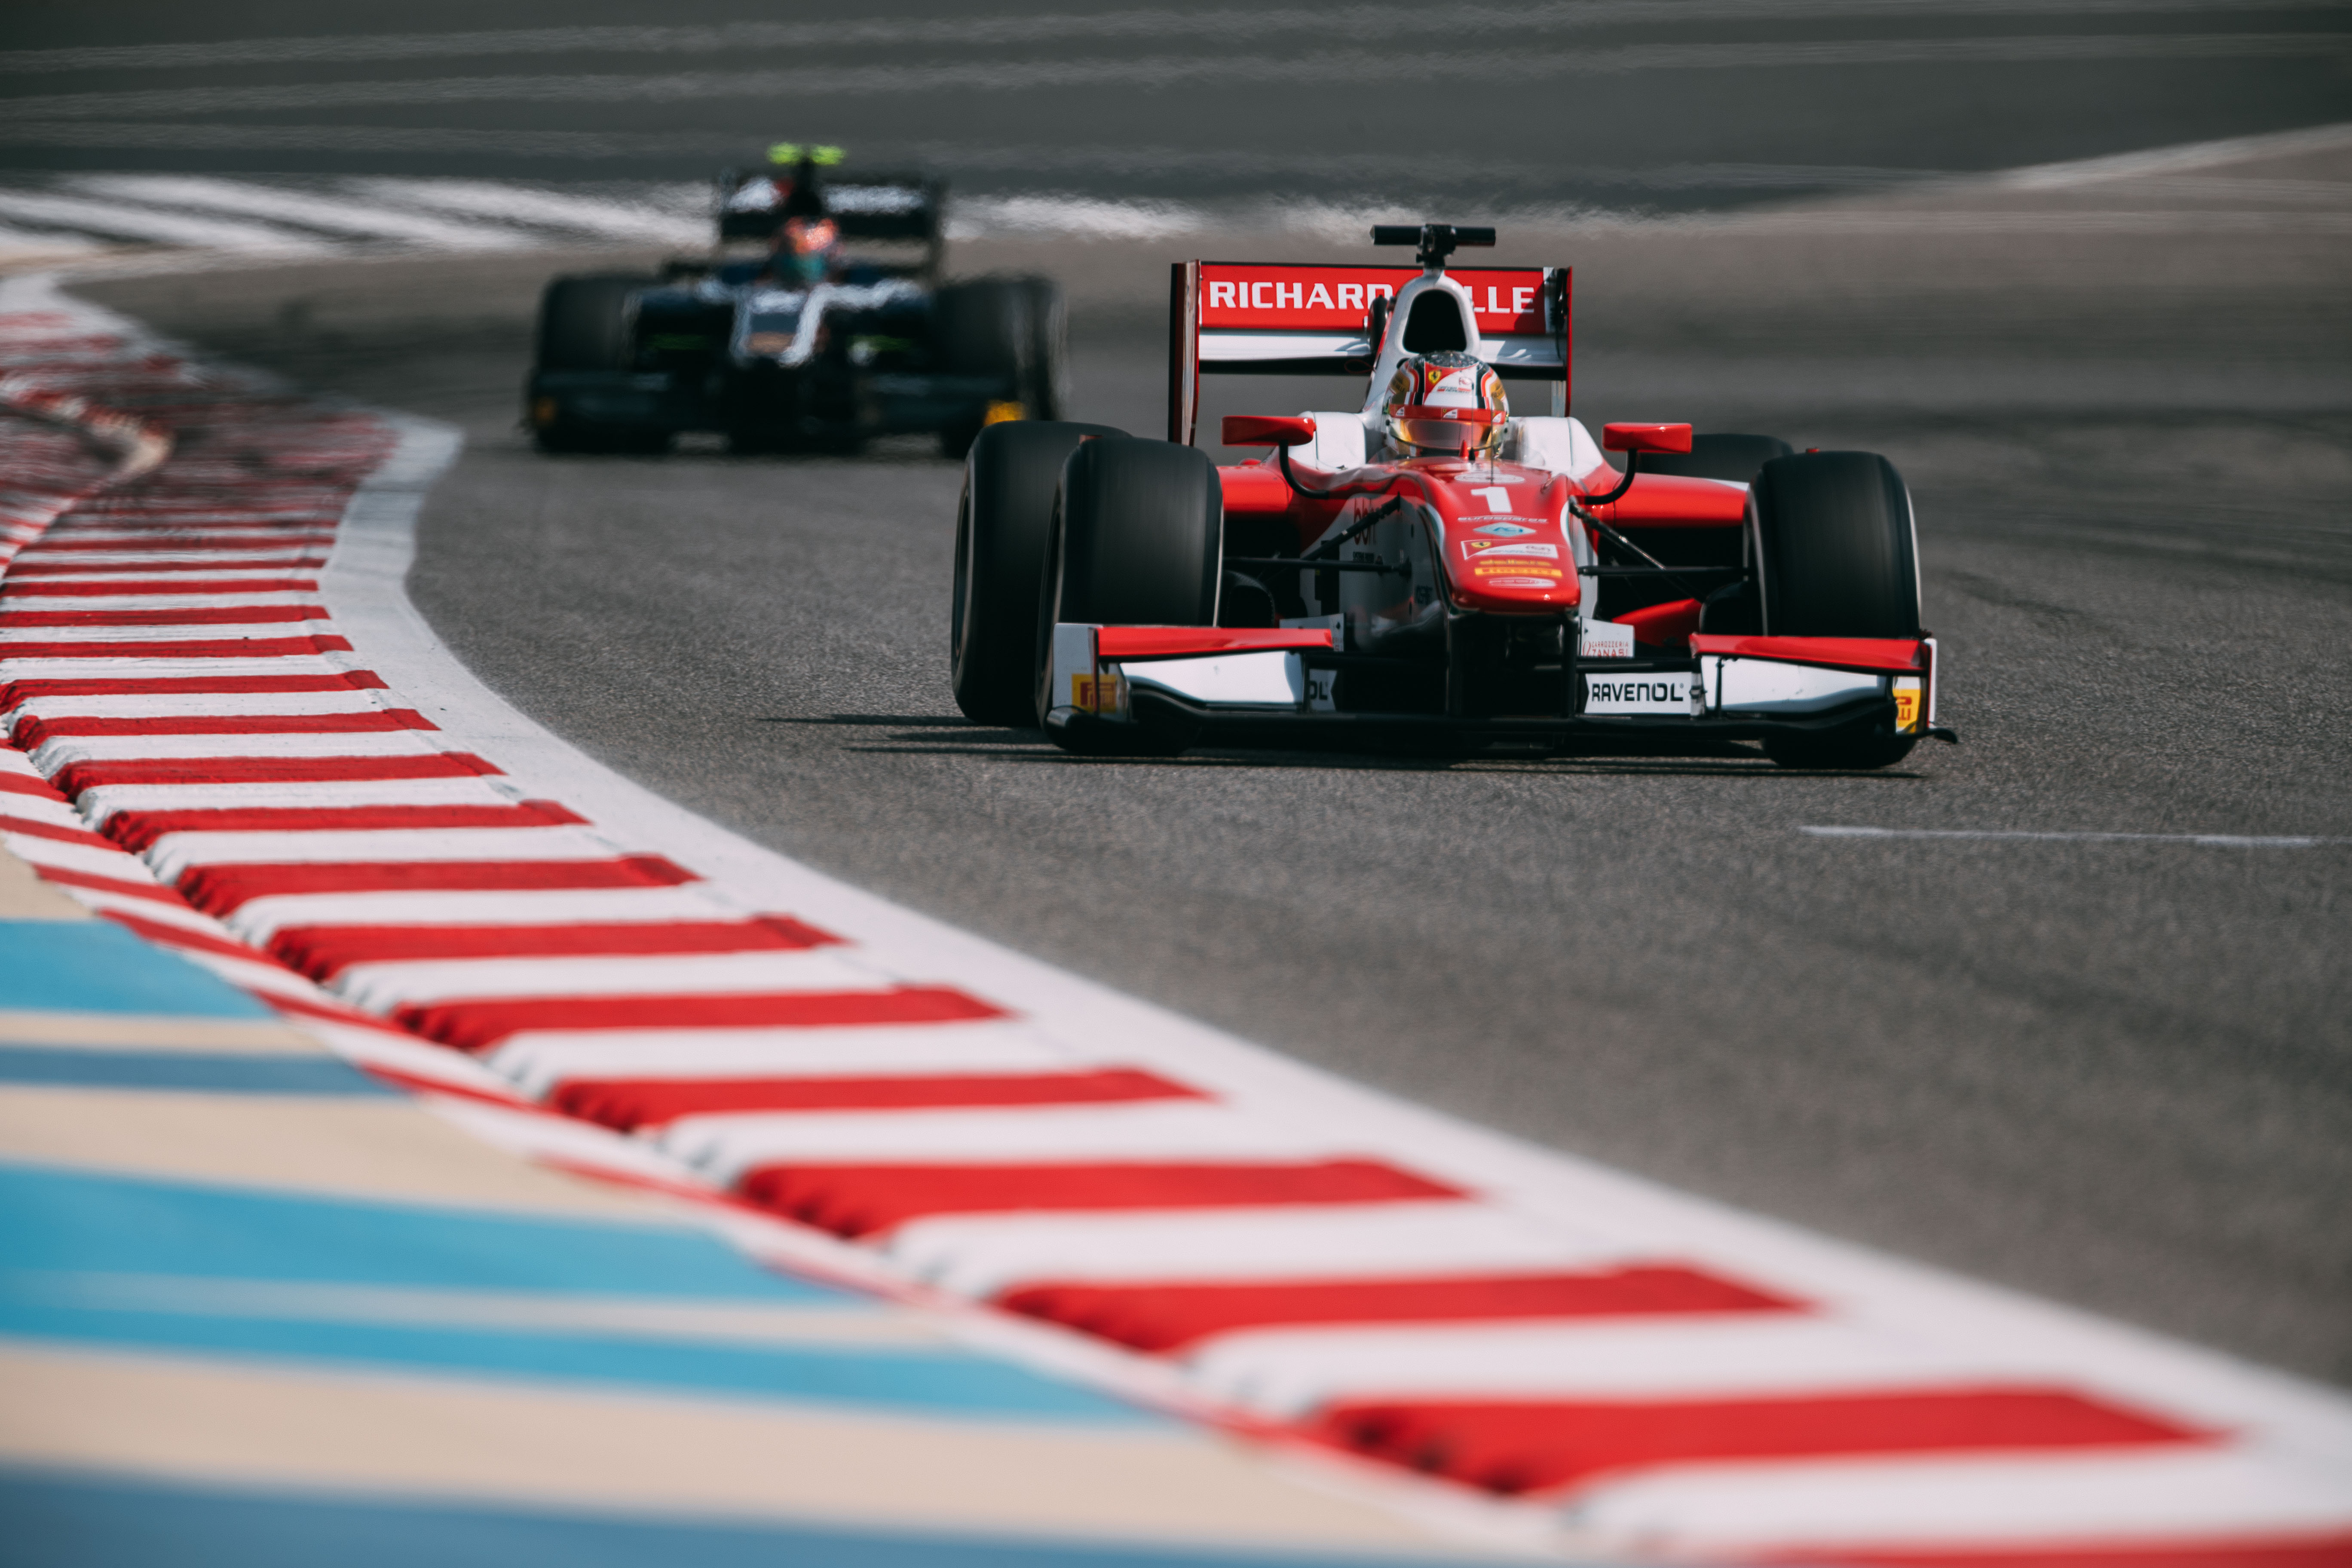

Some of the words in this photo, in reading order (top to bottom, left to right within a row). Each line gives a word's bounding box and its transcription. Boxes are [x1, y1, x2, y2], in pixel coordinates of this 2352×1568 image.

[1464, 285, 1534, 313] LLE
[1470, 487, 1513, 513] 1
[1592, 683, 1684, 701] RAVENOL
